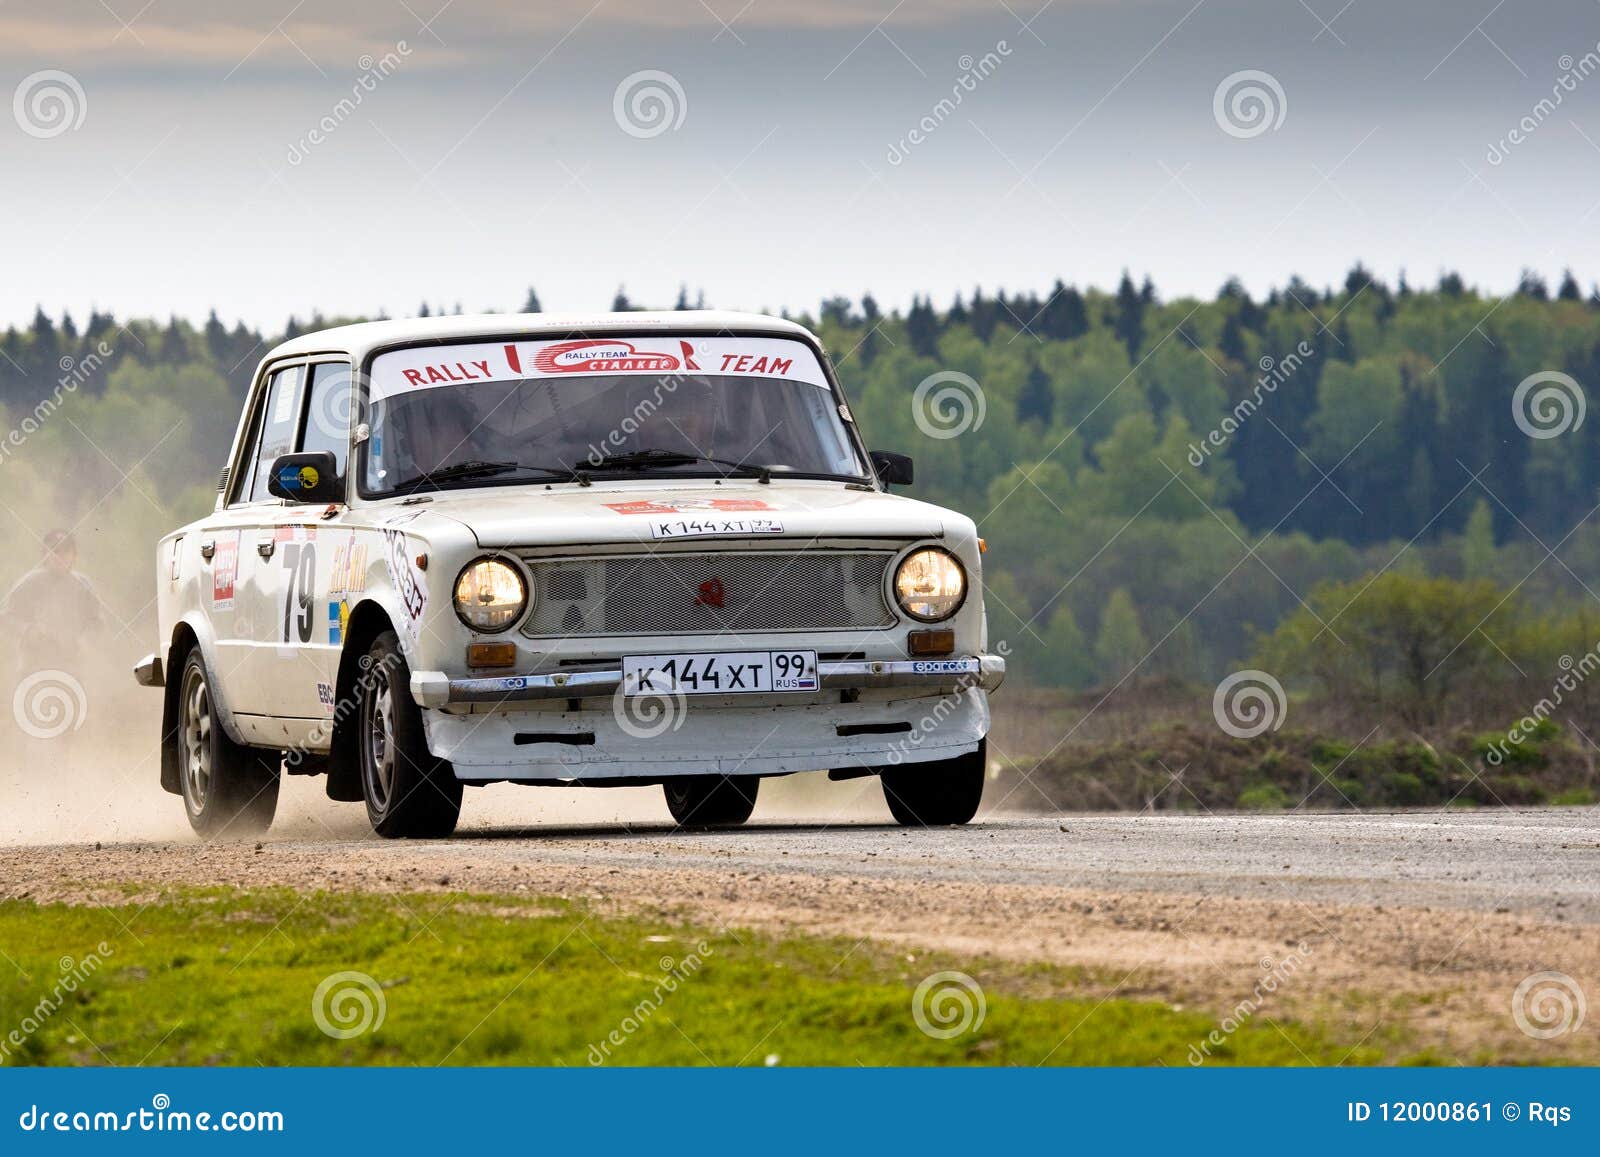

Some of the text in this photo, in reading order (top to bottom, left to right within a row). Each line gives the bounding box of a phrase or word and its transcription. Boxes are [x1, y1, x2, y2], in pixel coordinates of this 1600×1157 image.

[402, 354, 793, 386] RALLY TEAM
[283, 542, 316, 643] 79
[775, 654, 805, 678] 99
[775, 678, 798, 688] RUS
